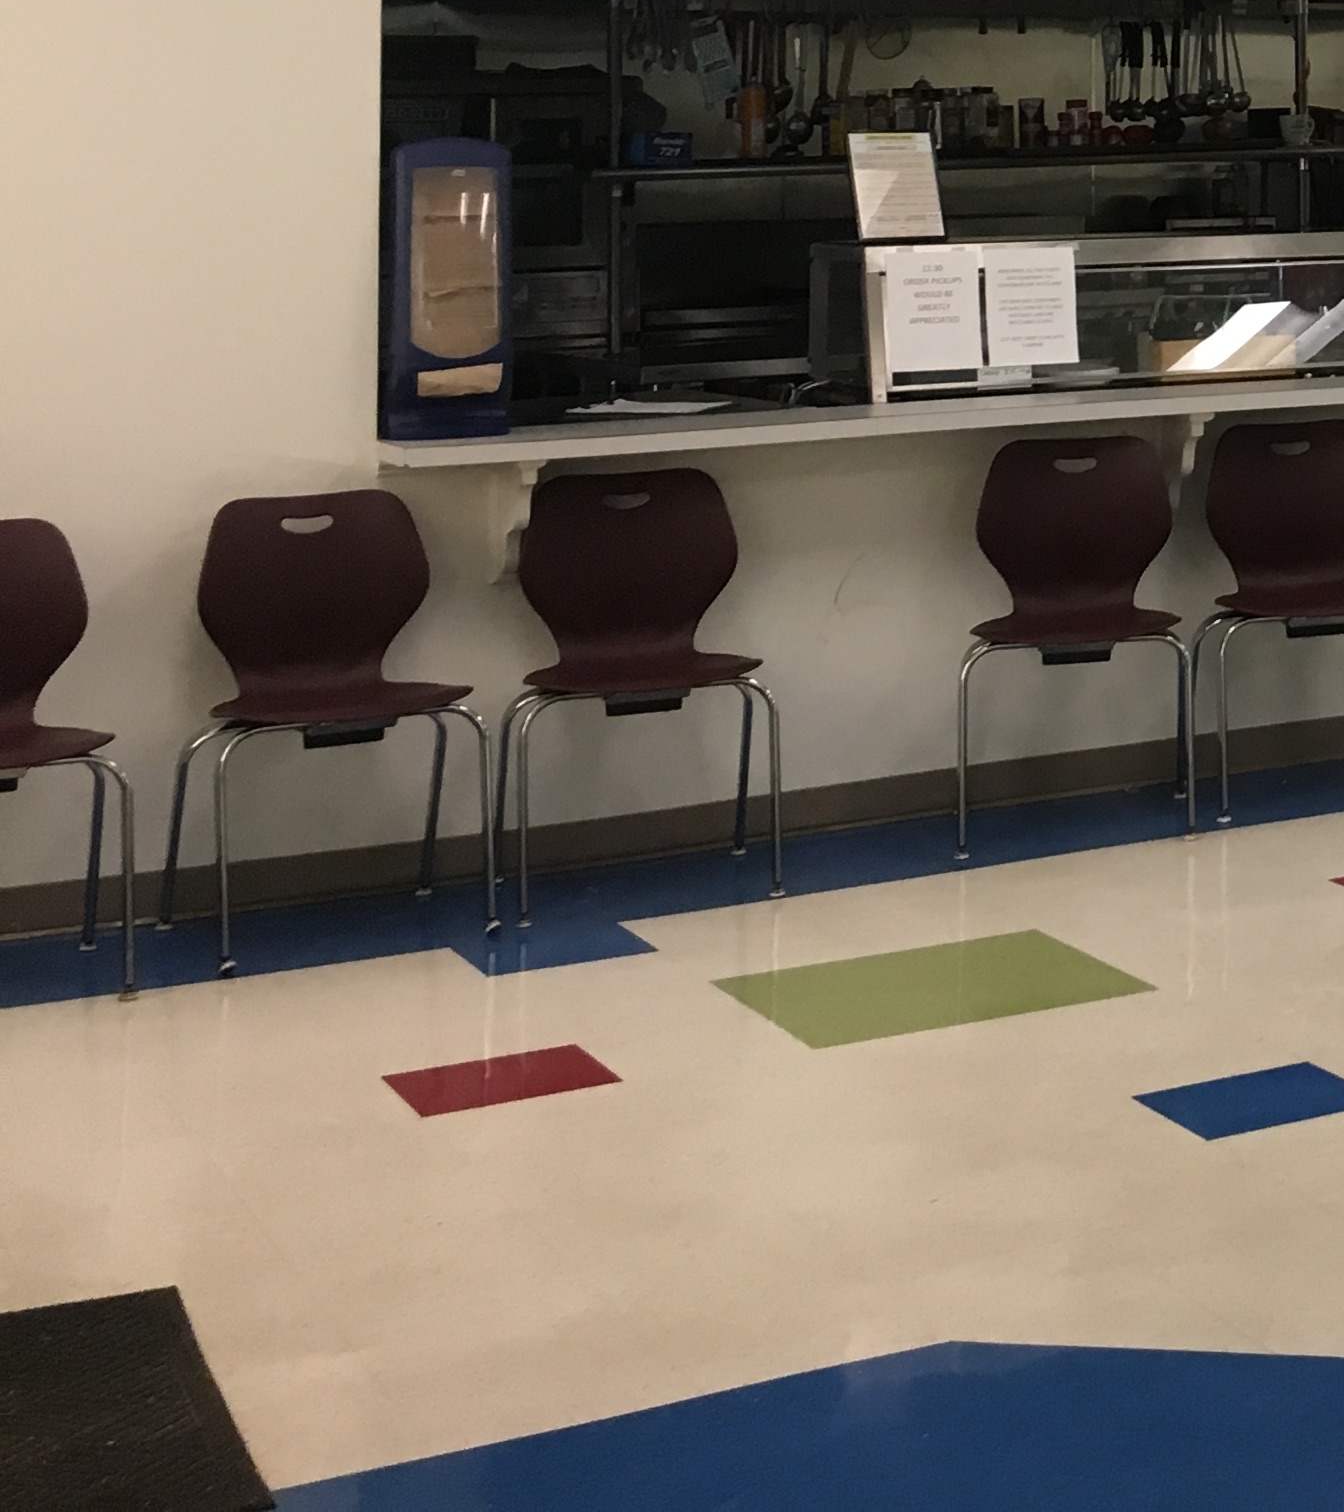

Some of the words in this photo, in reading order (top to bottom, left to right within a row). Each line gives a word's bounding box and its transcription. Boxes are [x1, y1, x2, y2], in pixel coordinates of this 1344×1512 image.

[931, 276, 963, 285] PICKUPS
[914, 290, 943, 299] WOULD
[909, 315, 961, 325] APPRECIATED
